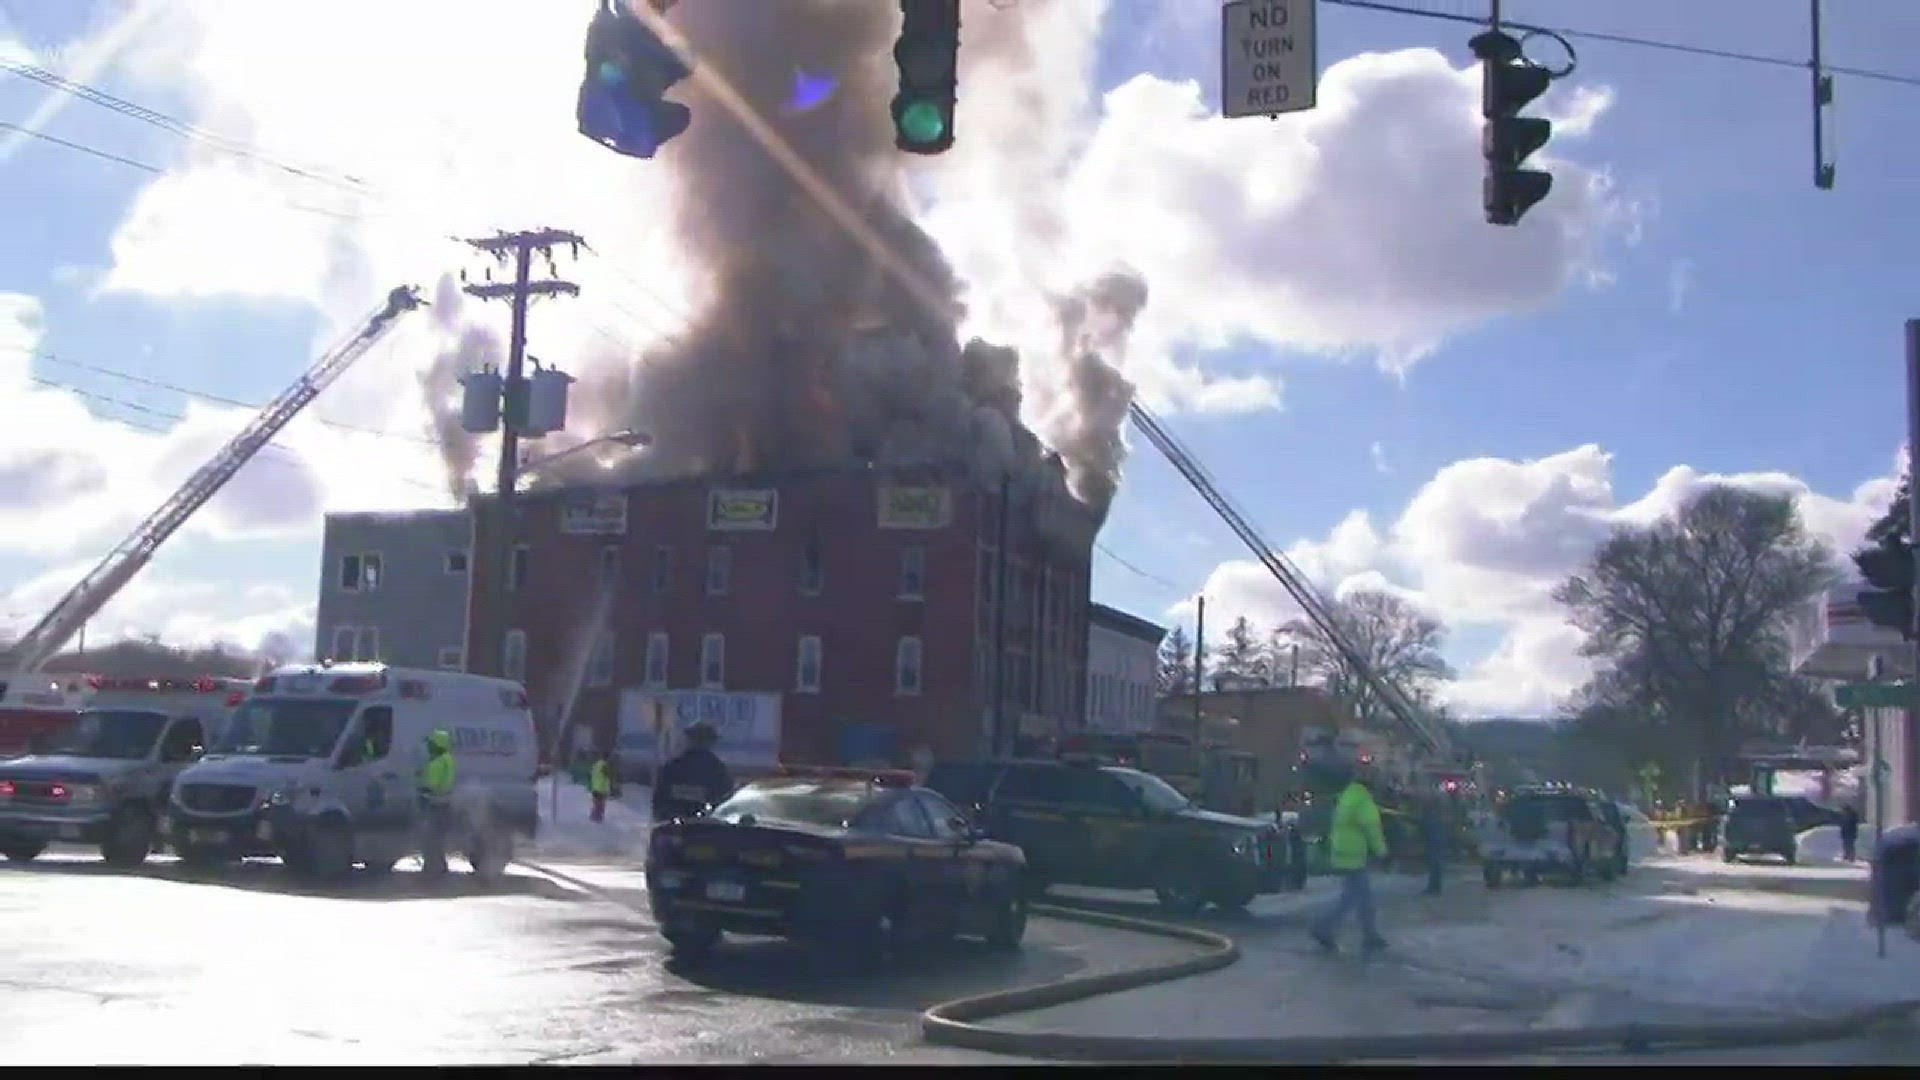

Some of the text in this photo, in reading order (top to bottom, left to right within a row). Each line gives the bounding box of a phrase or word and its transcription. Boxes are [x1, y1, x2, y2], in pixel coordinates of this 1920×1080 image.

[1250, 6, 1288, 28] NO
[1241, 36, 1294, 57] TURN
[1253, 63, 1281, 82] ON
[1247, 85, 1289, 105] RED
